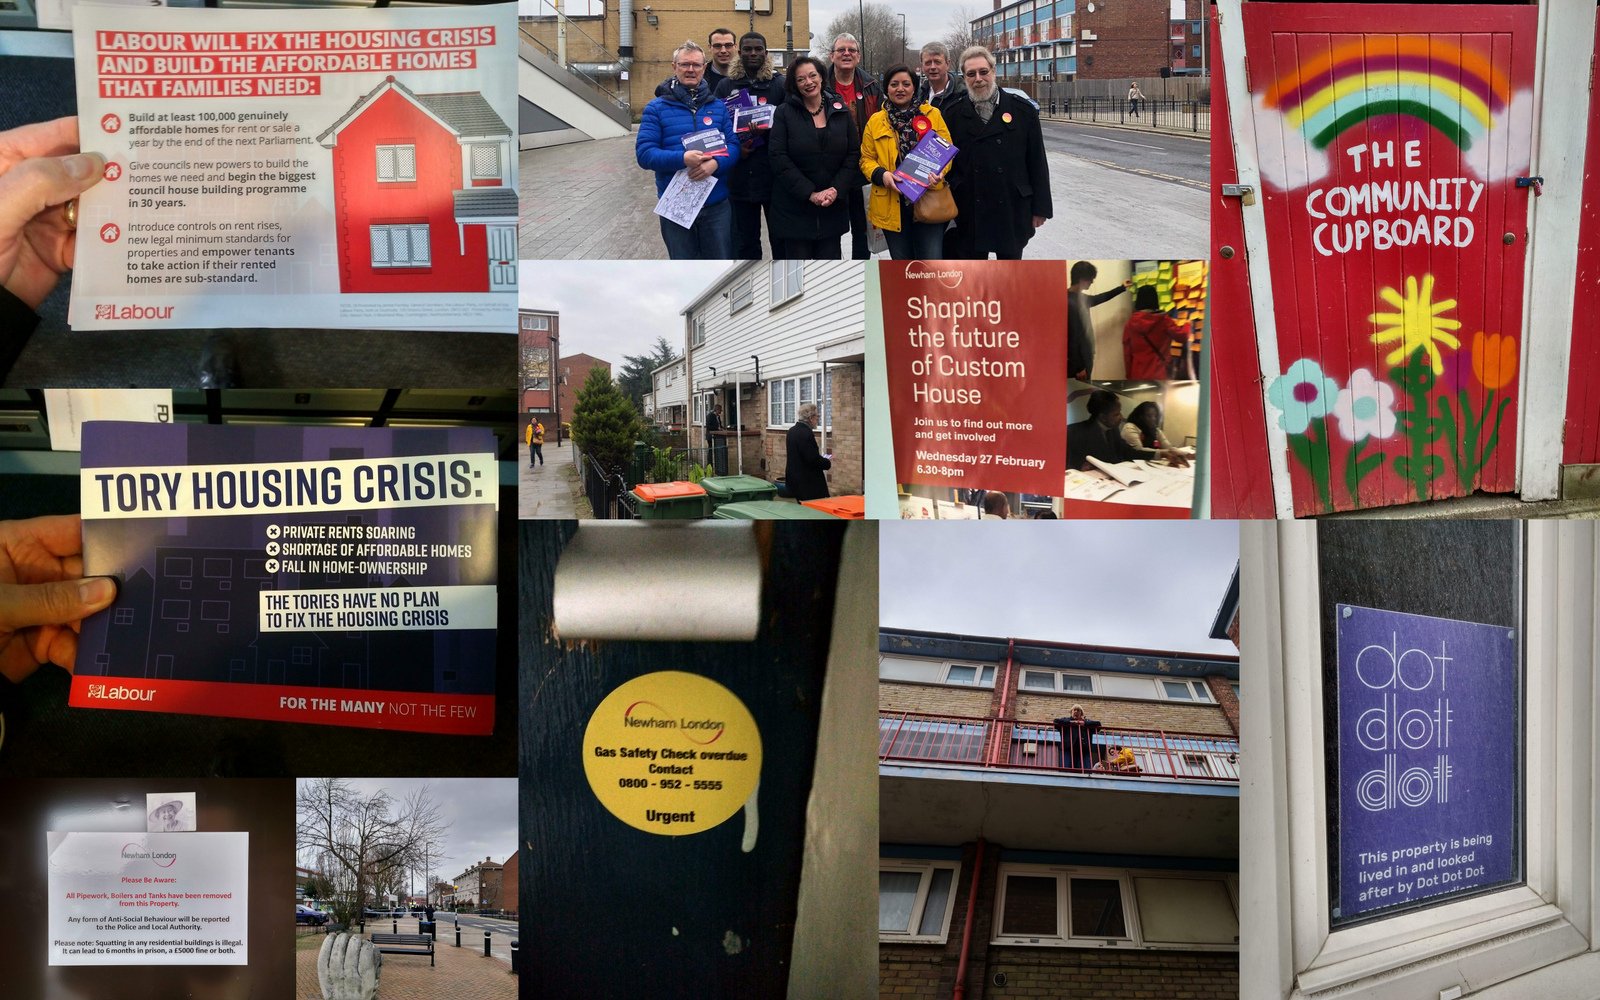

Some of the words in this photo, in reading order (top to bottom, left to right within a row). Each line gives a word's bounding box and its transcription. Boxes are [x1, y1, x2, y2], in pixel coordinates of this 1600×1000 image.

[100, 32, 185, 50] LABOUR
[190, 34, 242, 50] WILL
[246, 33, 278, 50] FIX
[282, 32, 320, 49] THE
[326, 31, 420, 49] HOUSING
[426, 28, 492, 46] CRISIS
[101, 57, 148, 74] AND
[153, 57, 214, 73] BUILD
[219, 56, 256, 73] THE
[261, 54, 391, 72] AFFORDABLE
[397, 52, 471, 69] HOMES
[101, 80, 156, 97] THAT
[162, 79, 252, 96] FAMILIES
[257, 78, 315, 95] NEED:
[129, 113, 154, 122] Build
[171, 113, 195, 121] least
[199, 112, 236, 121] 100,000
[238, 111, 288, 122] genuinely
[1347, 140, 1422, 172] THE
[1306, 178, 1484, 218] COMMUNITY
[129, 223, 174, 231] Introduce
[177, 222, 216, 230] controls
[258, 221, 282, 230] rises,
[151, 235, 173, 246] legal
[176, 235, 222, 243] minimum
[226, 234, 274, 243] standards
[277, 233, 291, 242] for
[1313, 214, 1474, 256] CUPBOARD
[128, 249, 178, 259] properties
[180, 248, 198, 256] and
[202, 249, 251, 258] empower
[141, 261, 164, 270] take
[167, 261, 199, 270] action
[203, 260, 210, 269] if
[212, 260, 238, 269] their
[241, 260, 276, 269] rented
[127, 275, 162, 283] homes
[185, 274, 257, 283] sub-standard.
[906, 270, 936, 280] Newham
[938, 270, 963, 279] London
[112, 305, 174, 319] Labour
[907, 296, 1001, 324] Shaping
[908, 326, 945, 346] the
[952, 325, 1019, 348] future
[912, 355, 932, 376] of
[939, 355, 1025, 378] Custom
[914, 383, 981, 404] House
[914, 417, 934, 426] Join
[950, 419, 961, 427] to
[964, 419, 983, 428] find
[936, 432, 951, 441] get
[954, 432, 995, 442] involved
[916, 451, 977, 464] Wednesday
[980, 454, 992, 464] 27
[996, 455, 1045, 469] February
[917, 465, 964, 478] 6.30-8pm
[95, 472, 181, 513] TORY
[192, 466, 341, 509] HOUSING
[353, 460, 483, 503] CRISIS:
[284, 526, 325, 538] PRIVATE
[329, 526, 363, 538] RENTS
[366, 527, 415, 539] SOARING
[283, 543, 337, 556] SHORTAGE
[341, 544, 354, 556] OF
[357, 544, 427, 557] AFFORDABLE
[432, 545, 471, 557] HOMES
[282, 560, 306, 572] FALL
[309, 561, 319, 573] IN
[323, 561, 427, 574] HOME-OWNERSHIP
[266, 595, 289, 610] THE
[293, 594, 339, 609] TORIES
[343, 593, 377, 608] HAVE
[381, 592, 399, 608] NO
[404, 592, 439, 607] PLAN
[266, 613, 281, 628] TO
[286, 613, 306, 628] FIX
[308, 612, 333, 627] THE
[338, 611, 398, 627] HOUSING
[402, 610, 448, 626] CRISIS
[101, 685, 156, 702] Labour
[280, 697, 306, 709] FOR
[311, 699, 336, 711] THE
[341, 700, 384, 713] MANY
[390, 703, 417, 715] NOT
[421, 704, 446, 717] THE
[451, 706, 476, 718] FEW
[624, 716, 676, 728] Newham
[681, 718, 724, 730] London
[595, 747, 616, 757] Gas
[620, 748, 657, 760] Safety
[661, 749, 696, 759] Check
[700, 752, 747, 761] overdue
[649, 764, 693, 775] Contact
[620, 779, 648, 788] 0800
[660, 780, 681, 789] 952
[694, 780, 722, 790] 5555
[646, 810, 695, 824] Urgent
[152, 851, 176, 859] London
[1359, 851, 1388, 864] This
[1392, 842, 1447, 861] property
[1451, 839, 1460, 849] is
[1463, 835, 1492, 846] being
[1360, 867, 1391, 883] lived
[1396, 865, 1407, 876] in
[1412, 859, 1434, 873] and
[1438, 852, 1474, 867] looked
[1359, 886, 1394, 901] after
[1398, 882, 1413, 893] by
[1418, 875, 1438, 888] Dot
[1442, 870, 1462, 883] Dot
[1466, 865, 1484, 878] Dot
